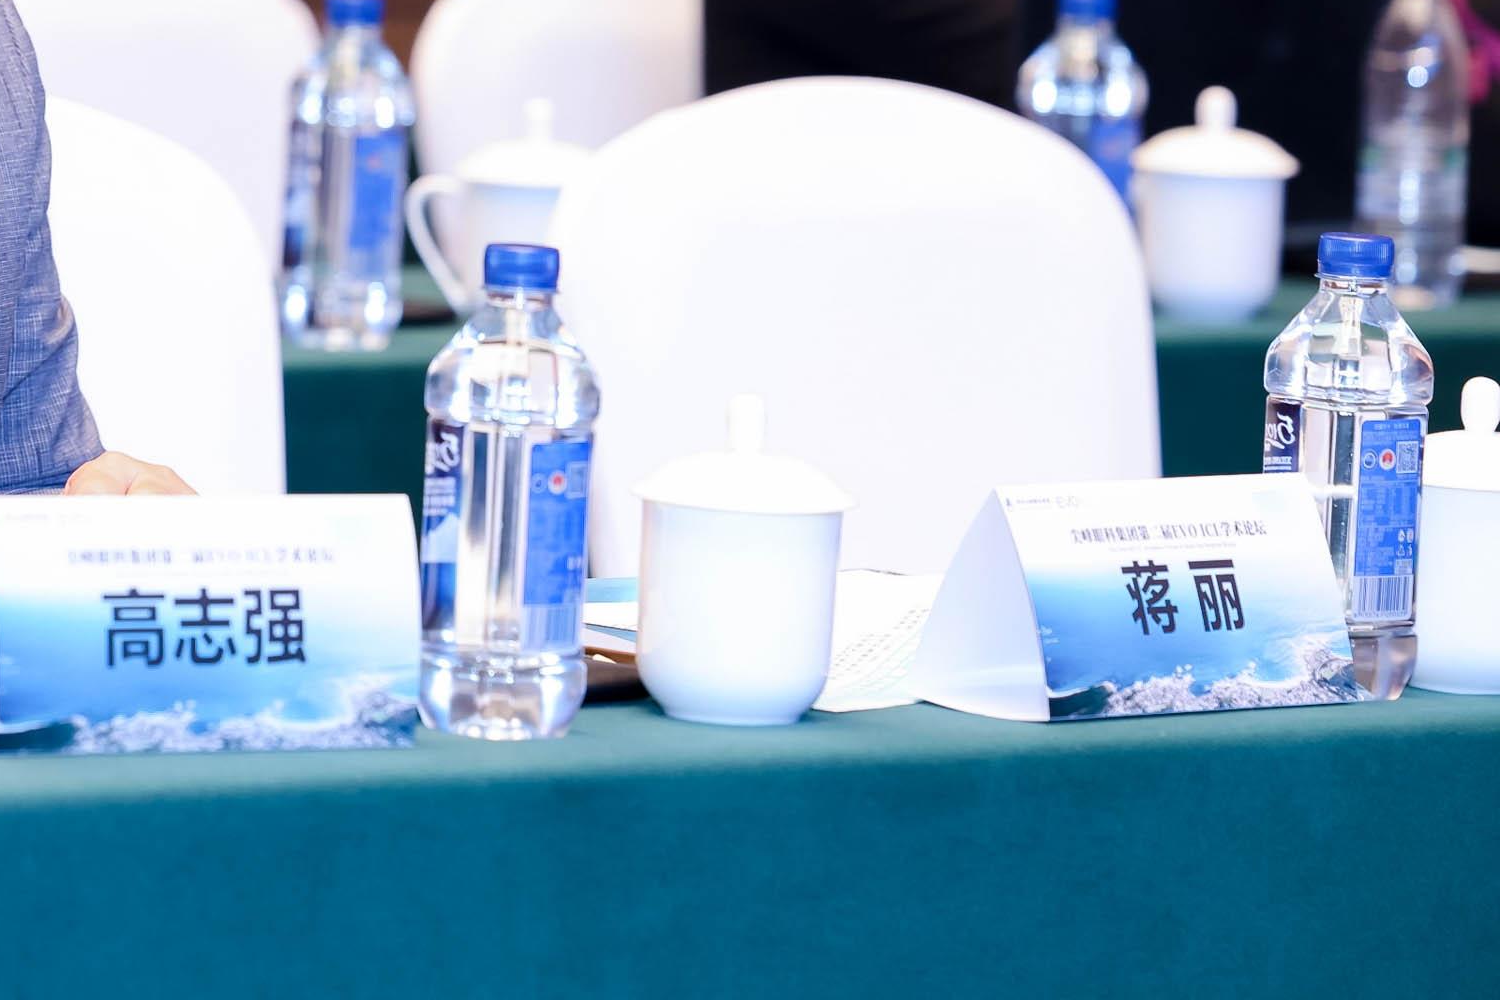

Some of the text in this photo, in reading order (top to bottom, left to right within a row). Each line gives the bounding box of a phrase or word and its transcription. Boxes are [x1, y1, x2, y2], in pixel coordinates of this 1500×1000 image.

[102, 587, 307, 667] 高志强
[1121, 559, 1246, 636] 蒋丽
